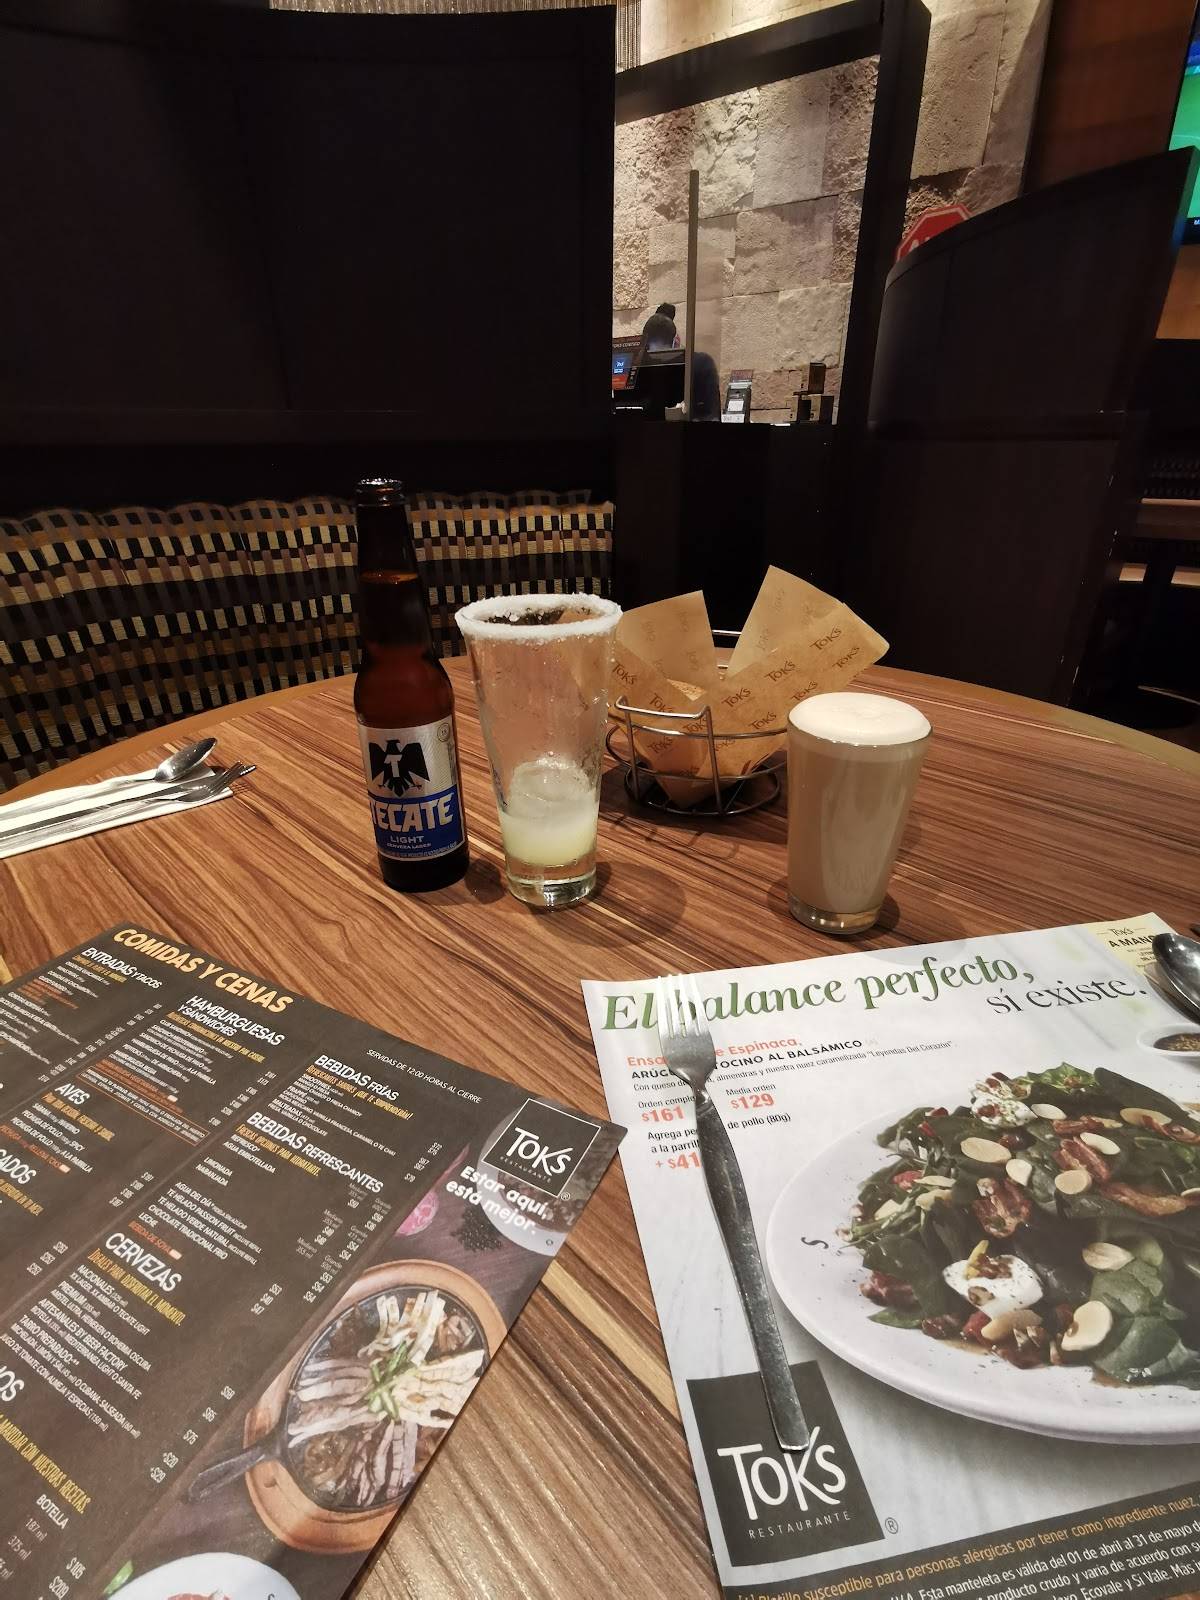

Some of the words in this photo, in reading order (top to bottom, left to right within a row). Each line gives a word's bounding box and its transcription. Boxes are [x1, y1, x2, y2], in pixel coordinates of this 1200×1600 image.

[81, 947, 137, 975] ENTRADAS
[135, 973, 162, 988] TACOS
[114, 929, 205, 972] COMIDAS
[198, 963, 224, 979] Y
[215, 973, 293, 1012] CENAS
[601, 992, 658, 1030] El
[855, 955, 1034, 1010] perfecto,
[1026, 979, 1148, 1009] existe.
[186, 995, 285, 1045] HAMBURGUESAS
[627, 1050, 667, 1066] Ensa
[769, 1053, 784, 1061] AL
[787, 1040, 862, 1058] BALSÁMICO
[314, 1055, 371, 1086] BEBIDAS
[367, 1081, 399, 1100] FRÍAS
[366, 1049, 397, 1066] SERVIDAS
[396, 1062, 407, 1070] DE
[423, 1075, 448, 1088] HORAS
[457, 1090, 482, 1103] CIERRE
[651, 1082, 676, 1090] queso
[54, 1083, 90, 1105] AVES
[638, 1100, 663, 1108] Orden
[665, 1093, 696, 1105] comple
[725, 1088, 751, 1096] Media
[752, 1084, 776, 1092] orden
[642, 1105, 683, 1122] $161
[731, 1093, 774, 1109] $129
[648, 1131, 682, 1141] Agrega
[741, 1117, 765, 1128] pollo
[247, 1112, 307, 1149] BEBIDAS
[301, 1143, 384, 1193] REFRESCANTES
[668, 1151, 701, 1169] $41
[671, 1139, 701, 1152] parrill
[0, 1149, 37, 1185] ADOS
[195, 1164, 228, 1186] NARANJADA
[204, 1157, 233, 1177] LIMONADA
[446, 1181, 485, 1205] está
[482, 1199, 535, 1235] mejor.
[460, 1166, 505, 1193] Estar
[501, 1190, 549, 1220] aquí,
[138, 1212, 158, 1227] LECHE
[148, 1204, 182, 1229] CHOCOLATE
[105, 1233, 182, 1292] CERVEZAS
[58, 1280, 87, 1305] PREMIUM
[77, 1265, 115, 1295] NACIONALES
[20, 1314, 41, 1334] TARRO
[36, 1298, 80, 1332] ARTESANALES
[74, 1327, 88, 1338] BY
[83, 1334, 101, 1351] BEER
[97, 1346, 128, 1371] FACTORY
[20, 1442, 40, 1461] CON
[32, 1454, 67, 1488] NUESTRAS
[59, 1479, 91, 1514] RECETAS.
[25, 1518, 40, 1532] 187
[36, 1494, 69, 1529] BOTELLA
[749, 1511, 851, 1540] RESTAURANTE
[8, 1536, 23, 1552] 375
[804, 1576, 873, 1600] susceptible
[875, 1570, 904, 1587] para
[906, 1556, 961, 1580] personas
[962, 1542, 1015, 1564] alérgicas
[1016, 1537, 1036, 1552] por
[1037, 1530, 1068, 1545] tener
[1071, 1521, 1103, 1537] como
[1102, 1505, 1166, 1528] ingrediente
[918, 1588, 945, 1600] Esta
[945, 1574, 1001, 1596] manteleta
[1002, 1570, 1016, 1581] es
[1016, 1560, 1049, 1577] válida
[1049, 1554, 1067, 1569] del
[1067, 1551, 1082, 1564] 01
[1083, 1548, 1098, 1560] de
[1099, 1540, 1123, 1556] abril
[1124, 1537, 1134, 1550] al
[1132, 1534, 1148, 1547] 31
[1148, 1531, 1163, 1543] de
[1163, 1525, 1192, 1539] mayo
[1039, 1574, 1071, 1591] crudo
[1072, 1573, 1080, 1584] y
[1110, 1560, 1125, 1572] de
[1126, 1549, 1169, 1568] acuerdo
[1170, 1544, 1191, 1557] con
[1080, 1580, 1123, 1600] Ecovale
[1124, 1579, 1133, 1591] y
[1143, 1569, 1172, 1583] Vale.
